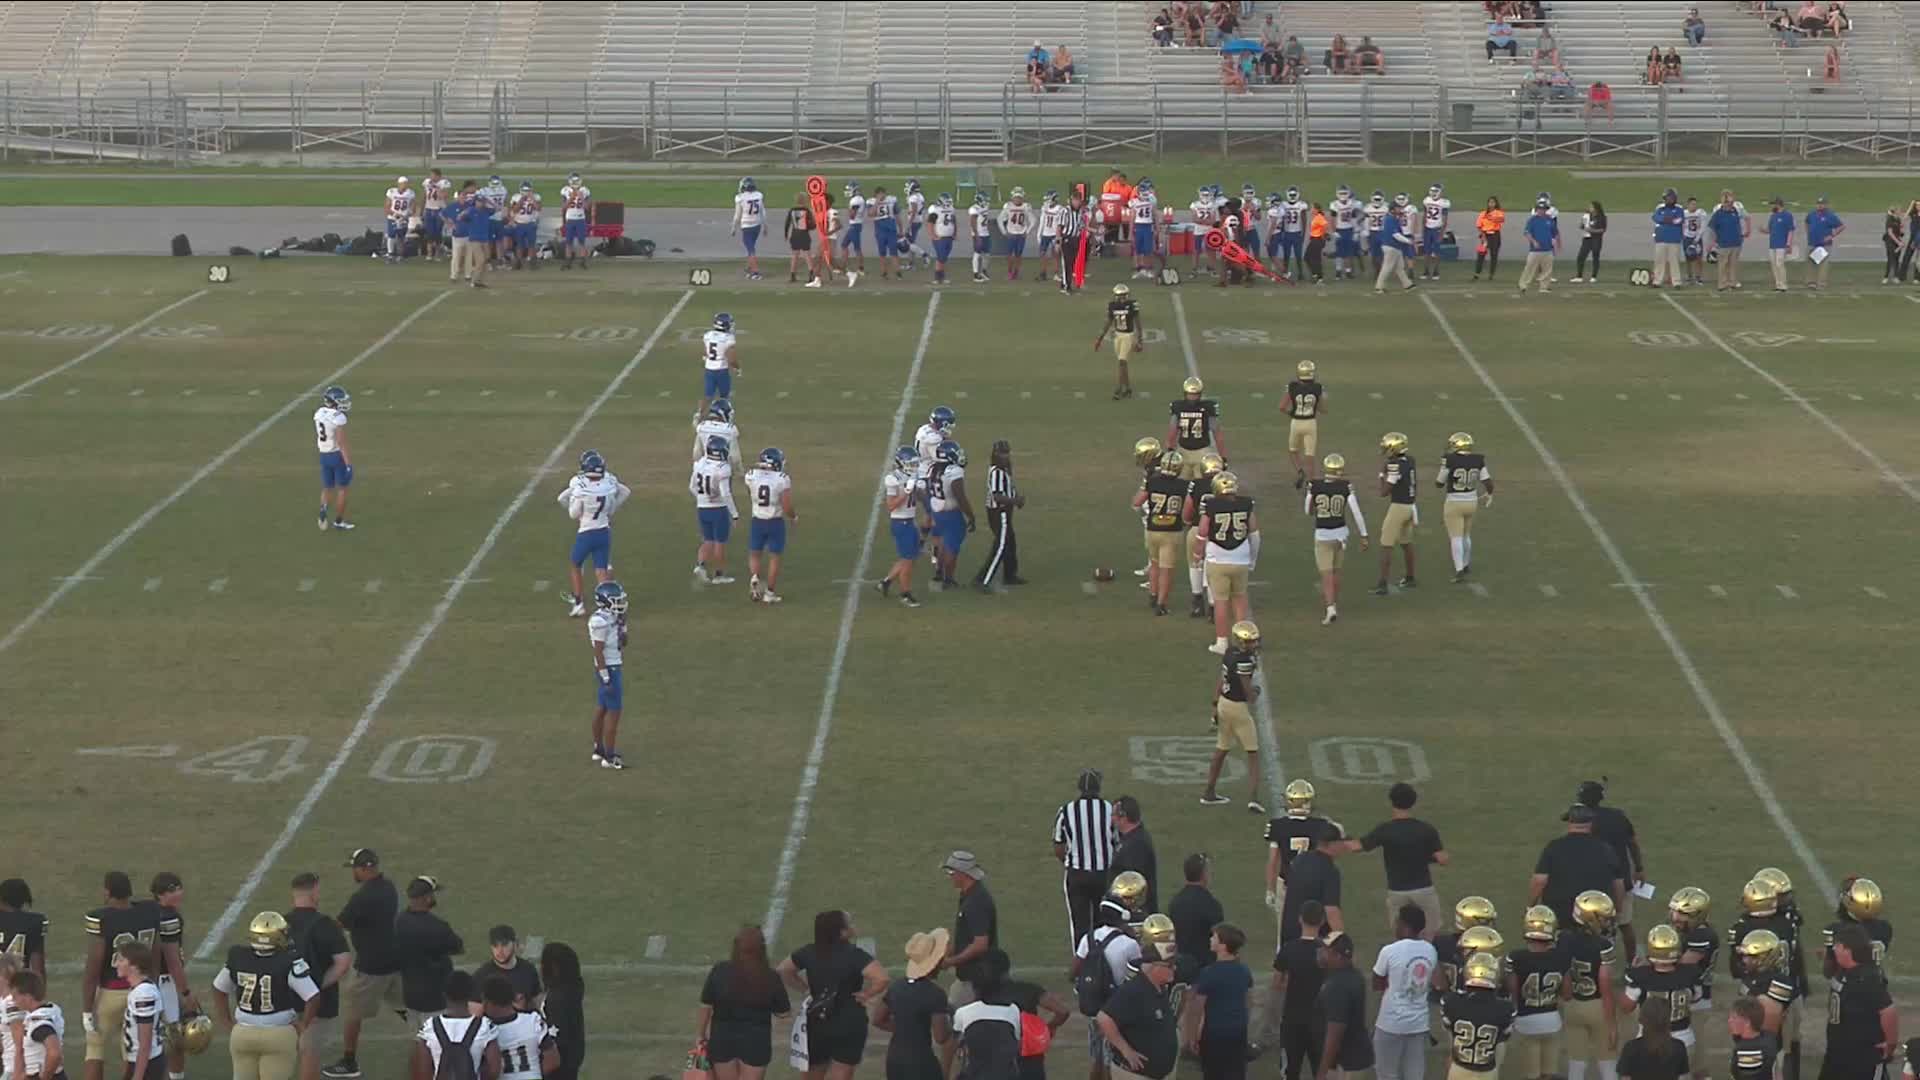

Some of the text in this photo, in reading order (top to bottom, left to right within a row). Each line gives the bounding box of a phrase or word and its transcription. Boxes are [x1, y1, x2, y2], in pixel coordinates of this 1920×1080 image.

[747, 199, 760, 215] 75
[208, 265, 227, 281] 30
[691, 269, 710, 285] 40
[1631, 269, 1649, 285] 40
[709, 342, 718, 361] 5
[319, 422, 327, 442] 3
[758, 484, 770, 507] 9
[1315, 494, 1345, 518] 20
[592, 495, 606, 520] 7
[1214, 511, 1248, 541] 75
[236, 971, 275, 1012] 71
[1521, 972, 1562, 1007] 42
[1453, 1019, 1498, 1064] 22
[501, 1045, 531, 1075] 11
